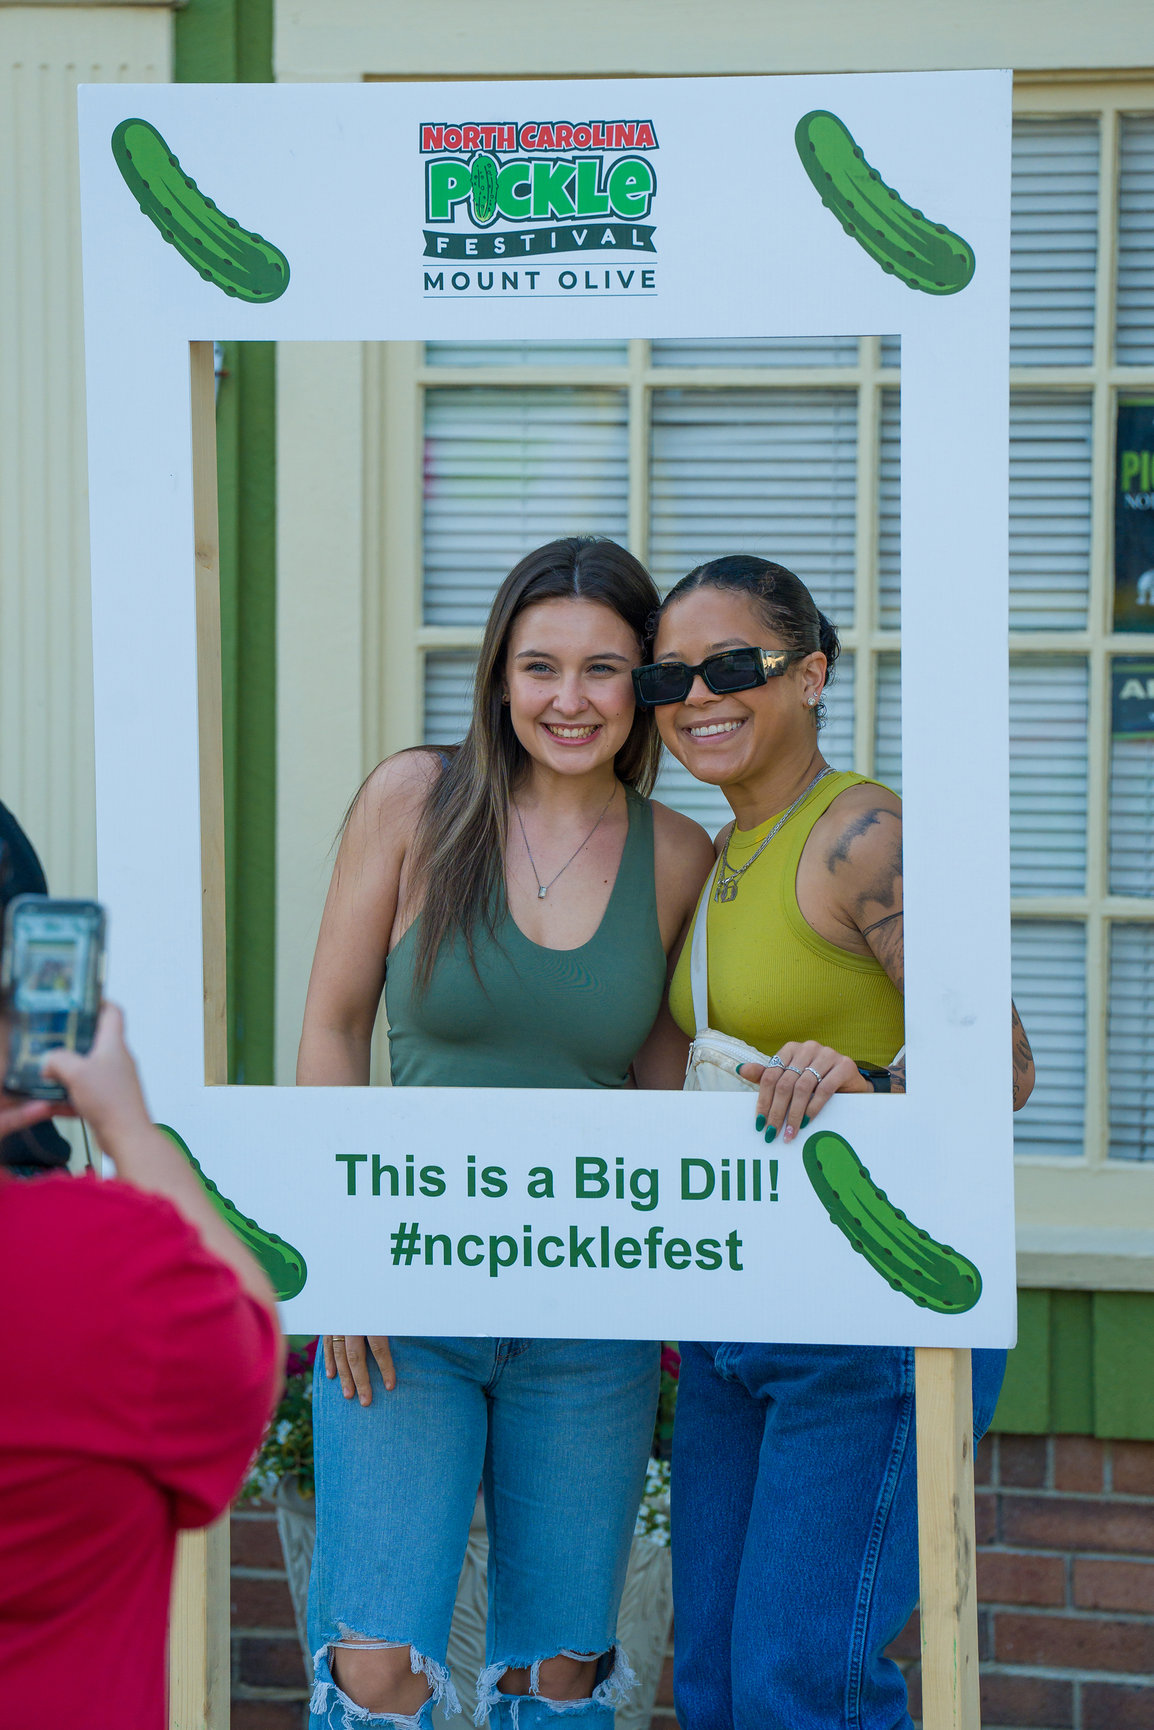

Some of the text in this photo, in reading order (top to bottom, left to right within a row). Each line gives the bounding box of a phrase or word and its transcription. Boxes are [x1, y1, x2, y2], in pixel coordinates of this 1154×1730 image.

[421, 121, 658, 152] NORTH CAROLINA
[436, 228, 645, 255] FESTIVAL
[424, 270, 656, 290] MOUNT OLIVE
[1122, 450, 1154, 492] PI
[335, 1154, 779, 1211] This is a Big Dill!
[390, 1222, 744, 1278] #ncpicklefest
